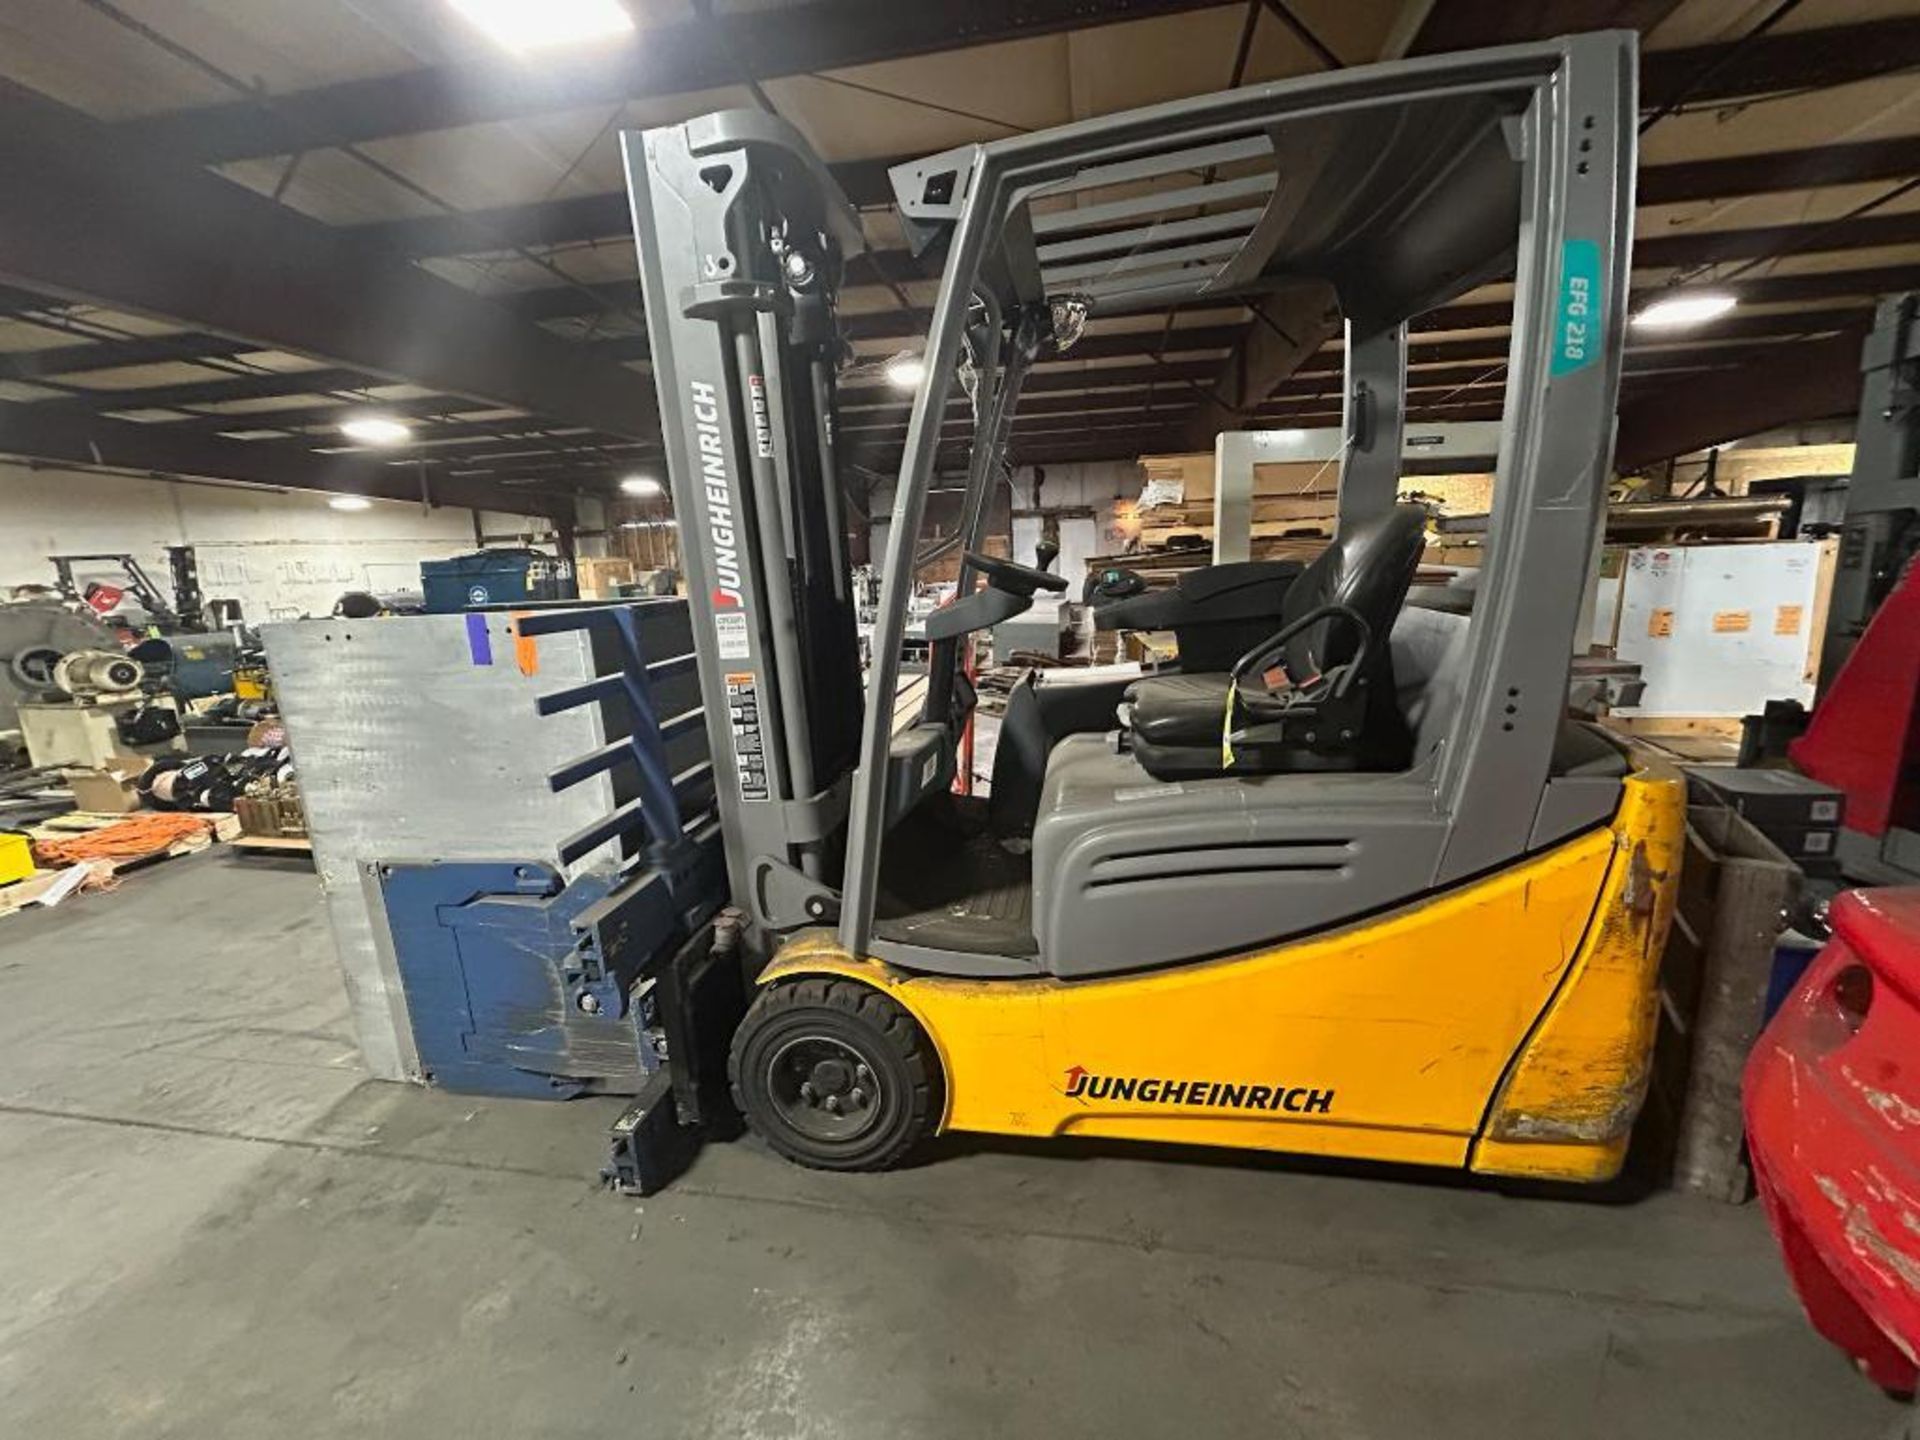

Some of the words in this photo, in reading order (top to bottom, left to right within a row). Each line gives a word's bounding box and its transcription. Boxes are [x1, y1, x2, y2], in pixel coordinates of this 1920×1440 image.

[1568, 276, 1589, 316] EFG
[1564, 320, 1586, 361] 218
[691, 381, 744, 608] JUNGHEINRICH
[1064, 1074, 1335, 1113] JUNGHEINRICH
